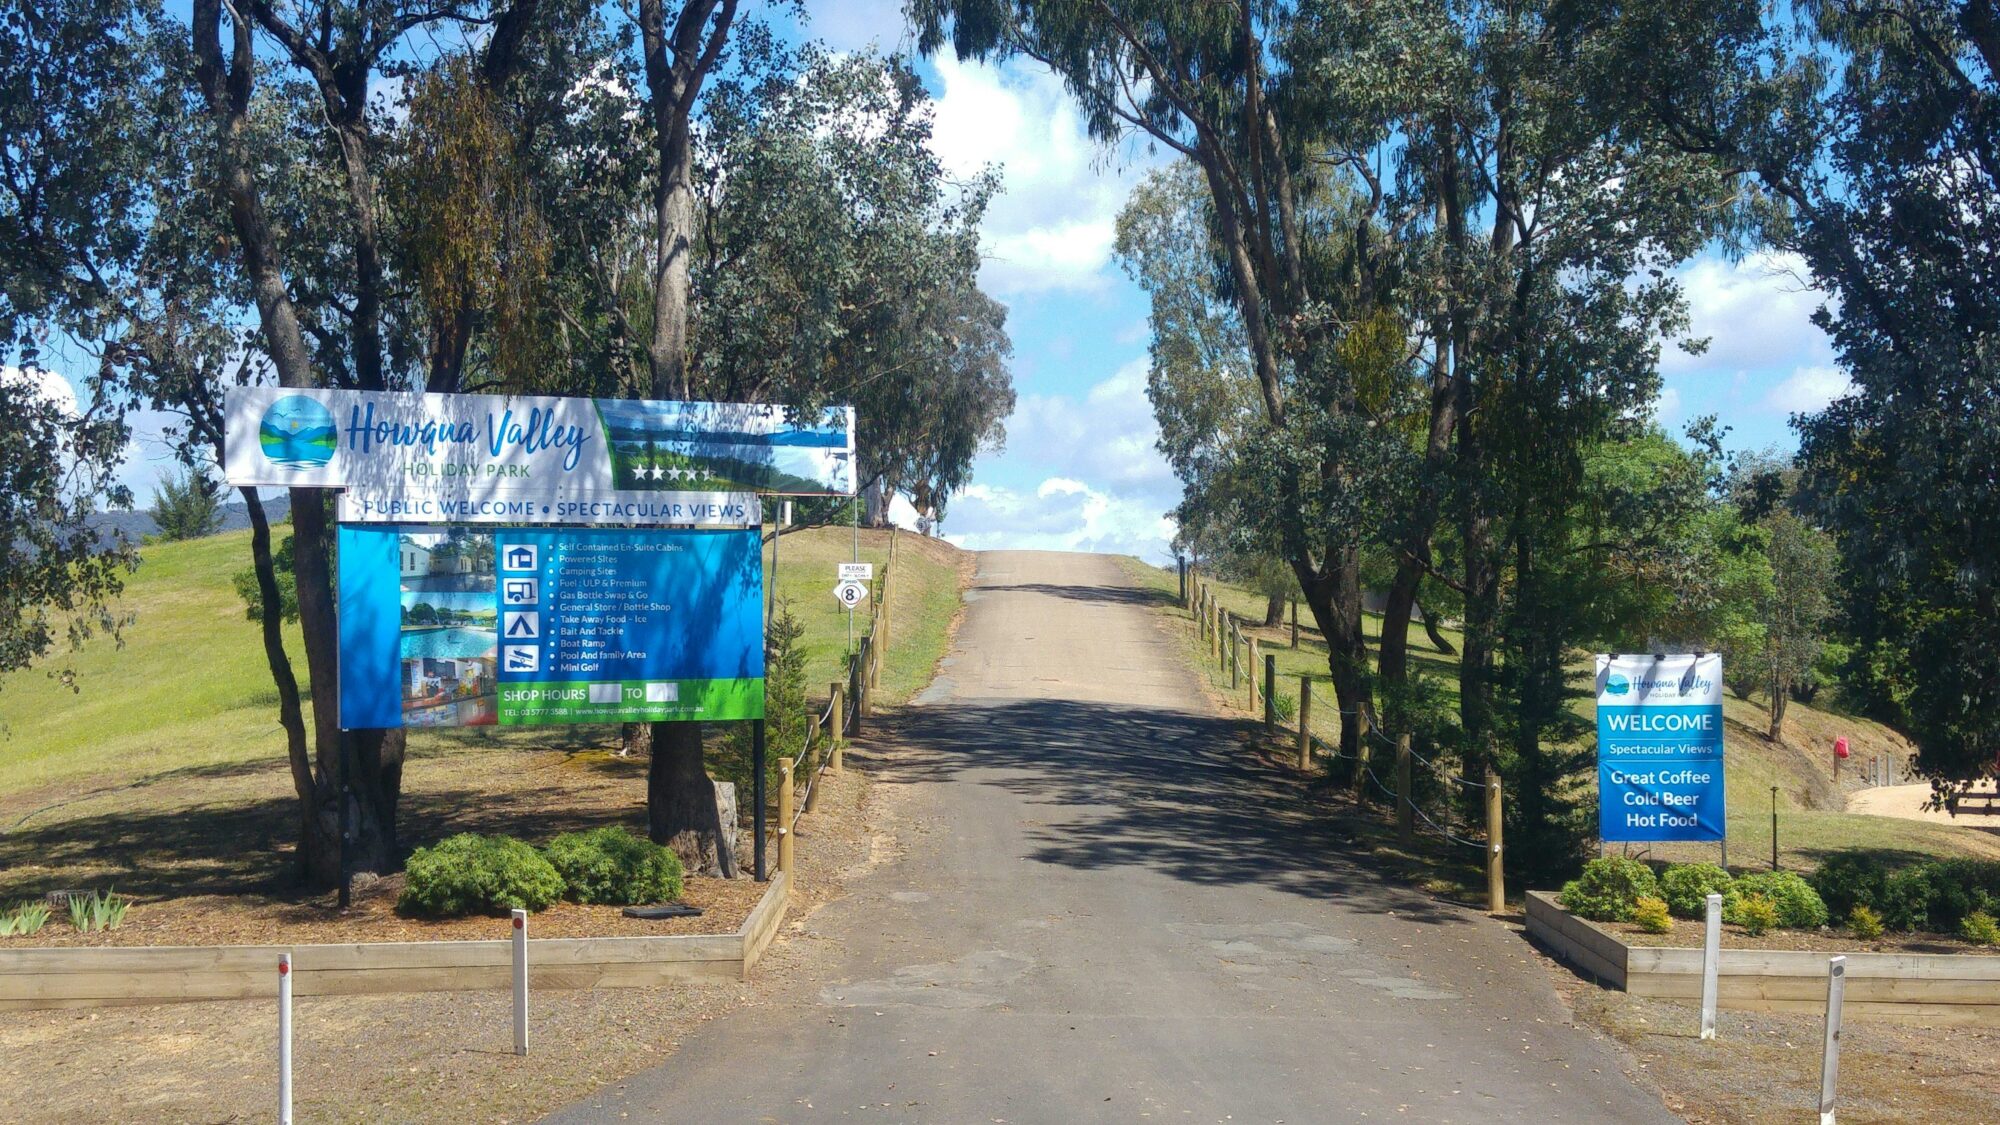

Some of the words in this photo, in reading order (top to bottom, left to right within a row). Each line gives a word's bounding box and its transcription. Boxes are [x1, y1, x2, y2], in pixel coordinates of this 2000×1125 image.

[344, 402, 480, 456] Howqua
[489, 407, 592, 471] Valley
[402, 462, 479, 477] HOLIDAY
[486, 464, 531, 478] PARK
[364, 500, 434, 515] PUBLIC
[440, 501, 535, 516] WELCOME
[557, 502, 683, 518] SPECTACULAR
[690, 503, 744, 518] VIEWS
[559, 543, 575, 551] Self
[576, 543, 619, 552] Contained
[656, 543, 684, 552] Cabins
[559, 555, 597, 563] Powered
[598, 555, 618, 563] Sites
[559, 567, 596, 576] Camping
[597, 567, 617, 575] Sites
[559, 579, 577, 588] Fuel
[583, 579, 600, 588] ULP
[610, 579, 647, 588] Premium
[559, 591, 576, 600] Gas
[577, 591, 603, 600] Bottle
[604, 591, 627, 601] Swap
[628, 592, 635, 600] &
[636, 591, 649, 600] Go
[845, 588, 854, 601] 8
[559, 603, 593, 612] General
[594, 603, 617, 612] Store
[623, 603, 649, 612] Bottle
[650, 602, 672, 612] Shop
[560, 615, 580, 624] Take
[581, 615, 605, 625] Away
[606, 614, 627, 624] Food
[635, 615, 648, 623] Ice
[560, 627, 578, 636] Bait
[579, 627, 597, 636] And
[598, 627, 625, 636] Tackle
[560, 639, 581, 648] Boat
[582, 639, 606, 649] Ramp
[560, 651, 580, 660] Pool
[581, 651, 598, 660] And
[599, 650, 626, 661] family
[627, 650, 647, 659] Area
[560, 663, 580, 672] Mini
[581, 662, 600, 671] Golf
[1632, 675, 1676, 692] Howqua
[1678, 674, 1713, 696] Valley
[503, 690, 539, 702] SHOP
[541, 688, 587, 701] HOURS
[625, 688, 643, 699] TO
[521, 708, 530, 716] 03
[531, 708, 549, 716] 5777
[1607, 714, 1713, 731] WELCOME
[1609, 743, 1676, 755] Spectacular
[1677, 743, 1713, 754] Views
[1611, 770, 1656, 785] Great
[1658, 770, 1711, 784] Coffee
[1624, 791, 1660, 806] Cold
[1663, 791, 1699, 806] Beer
[1627, 813, 1656, 827] Hot
[1659, 812, 1698, 827] Food
